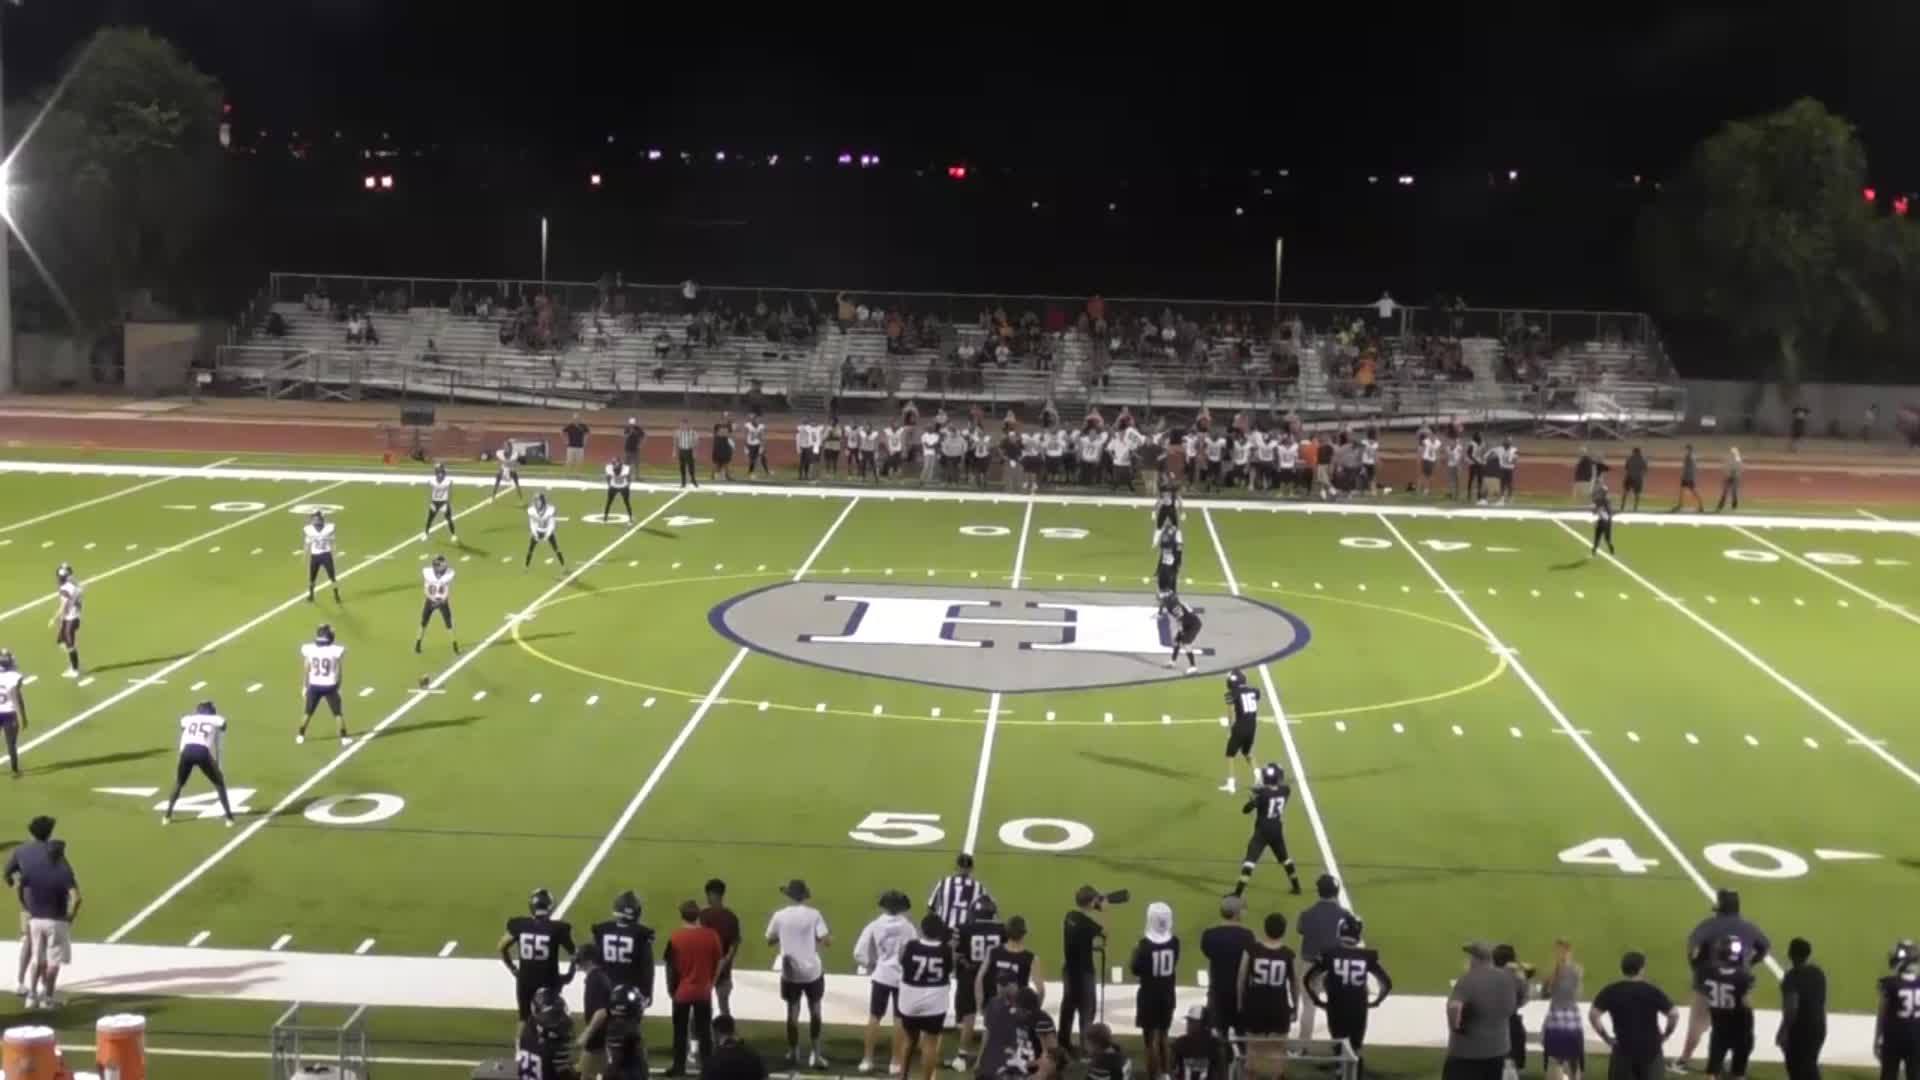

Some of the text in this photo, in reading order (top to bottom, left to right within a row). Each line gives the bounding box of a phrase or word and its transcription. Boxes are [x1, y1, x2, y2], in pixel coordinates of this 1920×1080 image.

[519, 934, 551, 961] 65
[603, 934, 634, 962] 62
[911, 955, 944, 982] 75
[1152, 949, 1174, 976] 10
[1253, 958, 1287, 987] 50
[1333, 957, 1368, 986] 42
[1704, 979, 1736, 1009] 36
